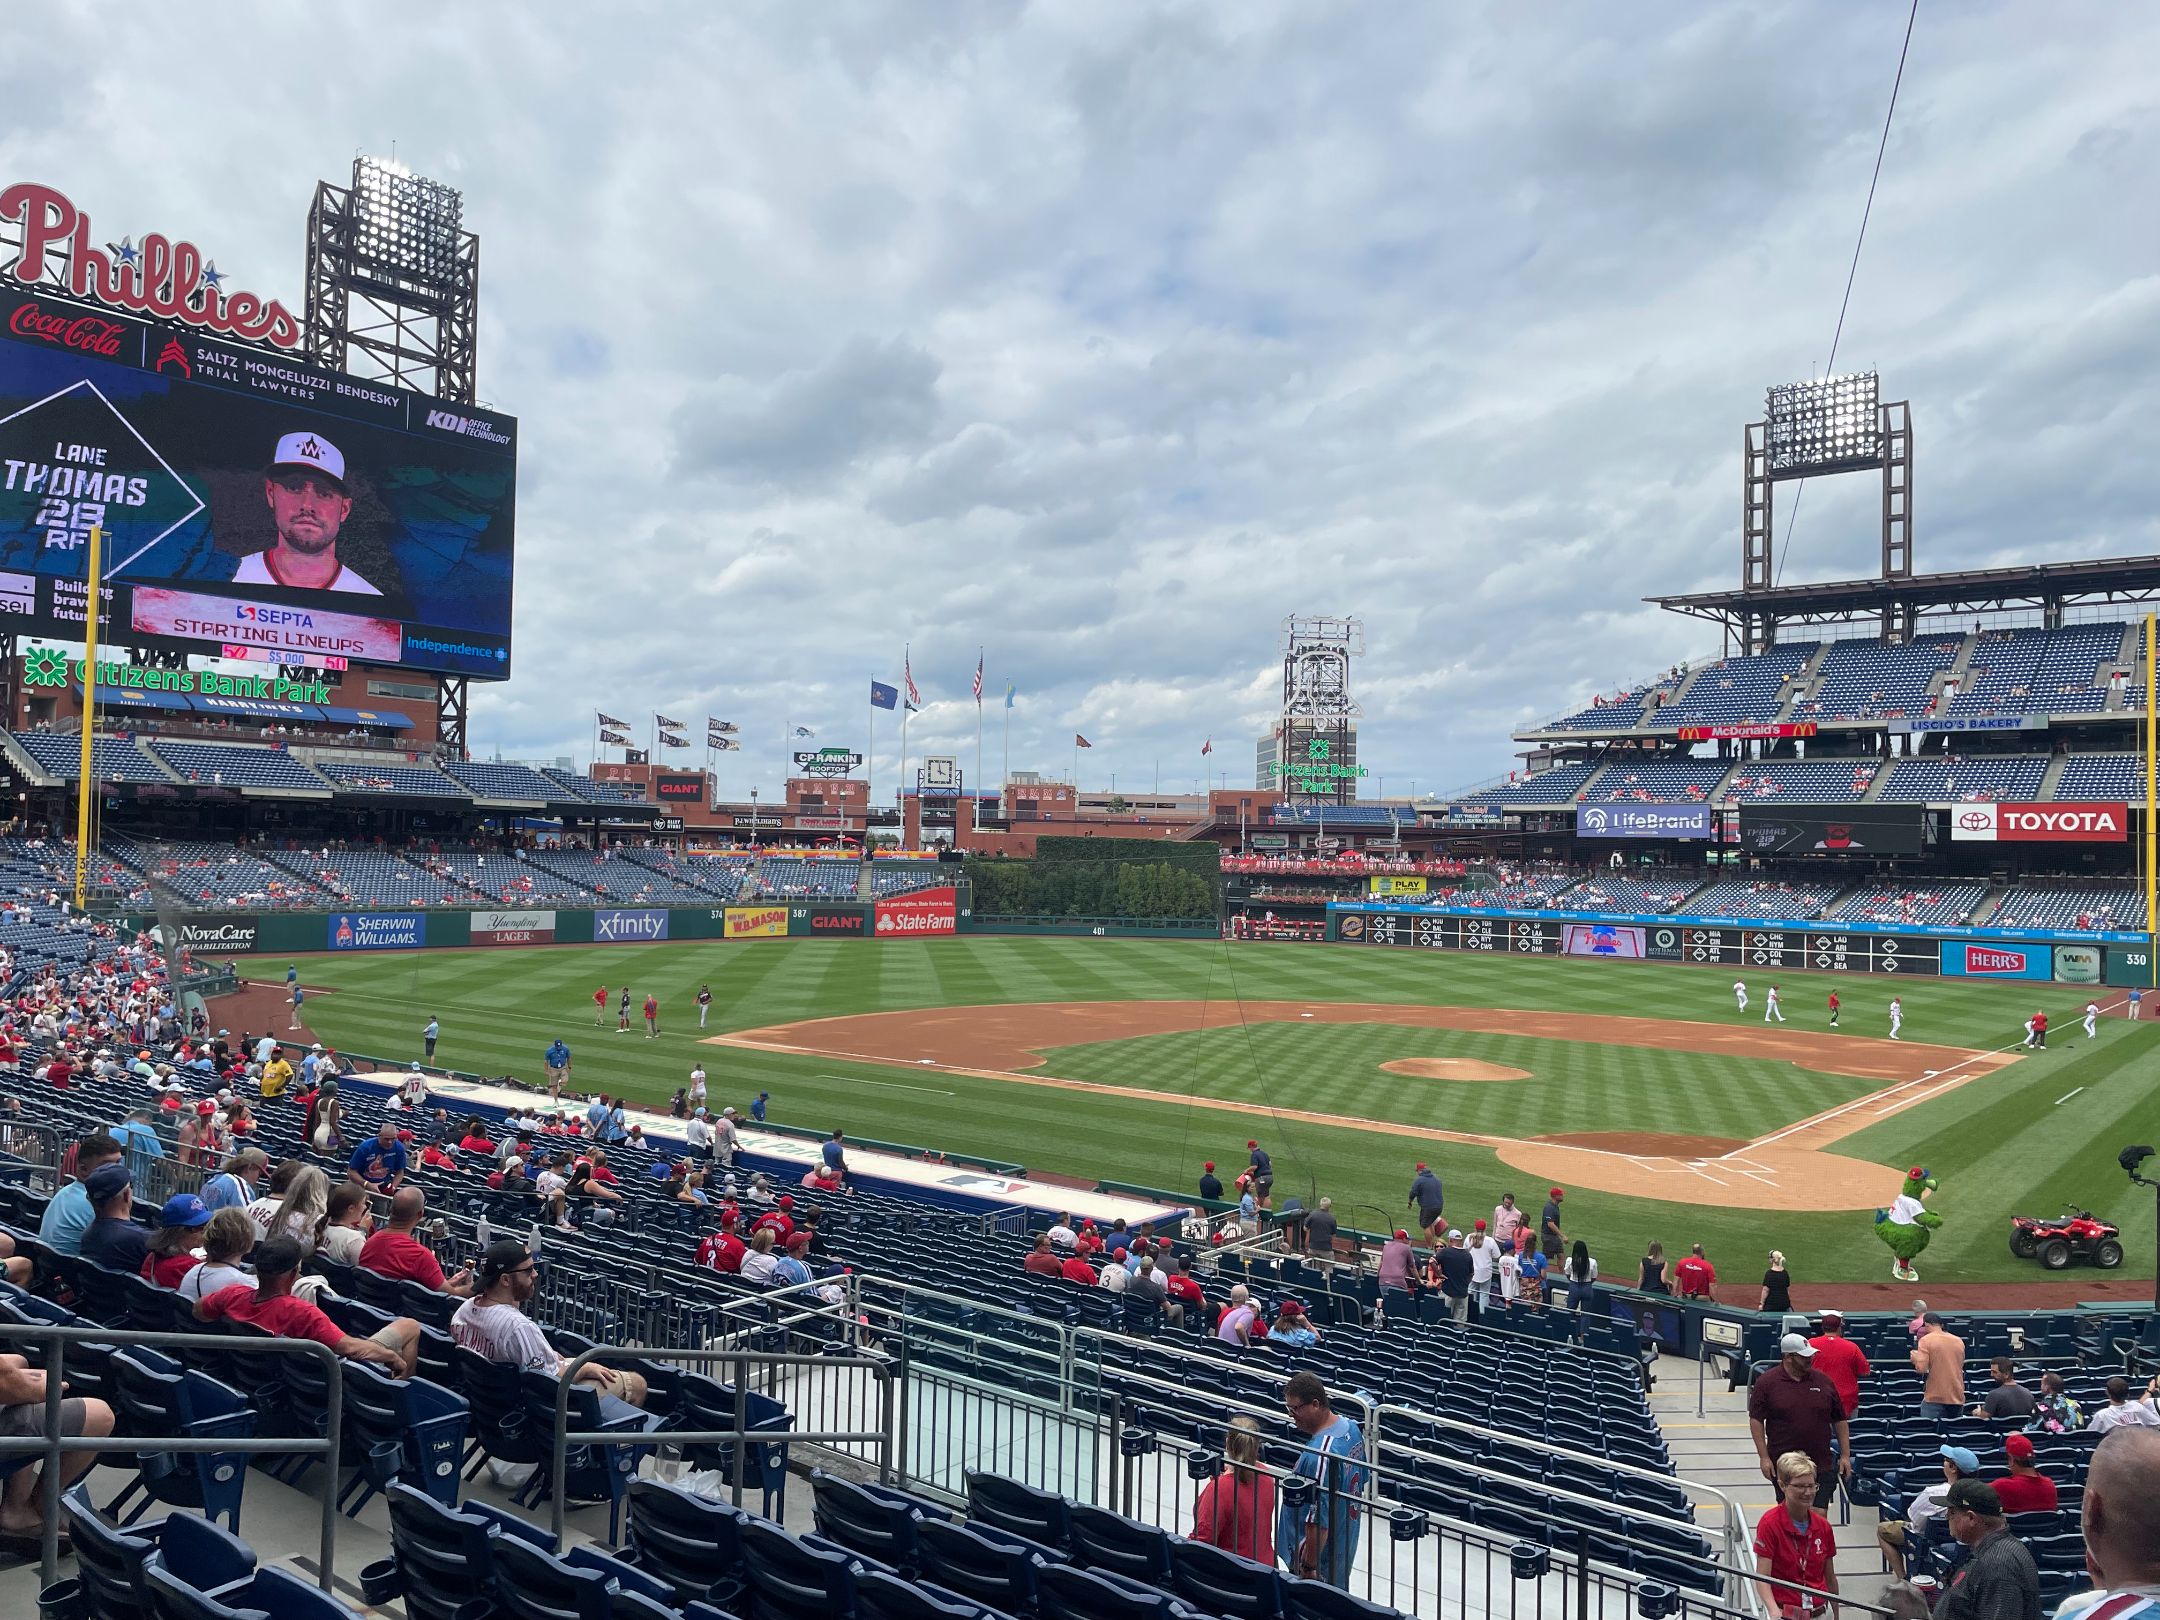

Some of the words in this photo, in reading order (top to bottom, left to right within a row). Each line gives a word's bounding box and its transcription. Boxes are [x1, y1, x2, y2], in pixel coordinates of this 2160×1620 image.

[0, 181, 302, 350] Phillies
[9, 303, 128, 357] Coca-Cola
[197, 349, 238, 368] SALTZ
[245, 360, 331, 391] MONGELUZZI
[336, 383, 400, 408] BENDESKY
[197, 364, 240, 382] TRIAL
[251, 377, 315, 400] LAWYERS
[425, 409, 468, 434] KDI
[468, 418, 493, 432] OFFICE
[466, 426, 511, 445] TECHNOLOGY
[55, 442, 108, 466] LANE
[5, 458, 148, 506] THOMAS
[35, 497, 106, 531] 28
[45, 528, 89, 550] RF
[257, 608, 314, 628] SEPTA
[173, 618, 278, 644] STARTING
[285, 631, 365, 654] LINEUPS
[407, 636, 493, 658] Independence
[74, 657, 194, 692] Citizens
[200, 670, 270, 700] Bank
[273, 679, 331, 705] Park
[205, 698, 258, 709] HARRY
[1910, 719, 1966, 730] LISCIO'S
[1968, 717, 2023, 729] BAKERY
[1711, 725, 1781, 737] McDonald's
[708, 735, 726, 749] 2022
[798, 753, 815, 762] CP
[816, 754, 858, 763] RANKIN
[1269, 760, 1328, 778] Citizens
[1330, 763, 1367, 778] Bank
[660, 784, 699, 794] GIANT
[1301, 779, 1334, 793] Park
[1613, 812, 1703, 829] LifeBrand
[2003, 812, 2117, 831] TOYOTA
[1746, 828, 1787, 837] THOMAS
[711, 910, 723, 919] 374
[792, 909, 807, 918] 387
[356, 916, 416, 931] SHERWIN
[487, 914, 541, 930] Yuengling
[599, 912, 665, 940] xfinity
[811, 916, 864, 928] GIANT
[179, 924, 255, 941] NovaCare
[496, 931, 530, 942] LAGER
[1092, 927, 1105, 936] 401
[1708, 930, 1721, 938] MIA
[2053, 931, 2096, 939] Independence
[1708, 947, 1720, 955] ATL
[1768, 941, 1784, 949] NYM
[1769, 950, 1783, 958] COL
[1971, 952, 2020, 969] HERR'S
[2126, 953, 2147, 966] 330
[1770, 958, 1783, 966] MIL
[410, 1081, 420, 1093] 17
[706, 1250, 717, 1268] 3
[1101, 1274, 1111, 1288] 3
